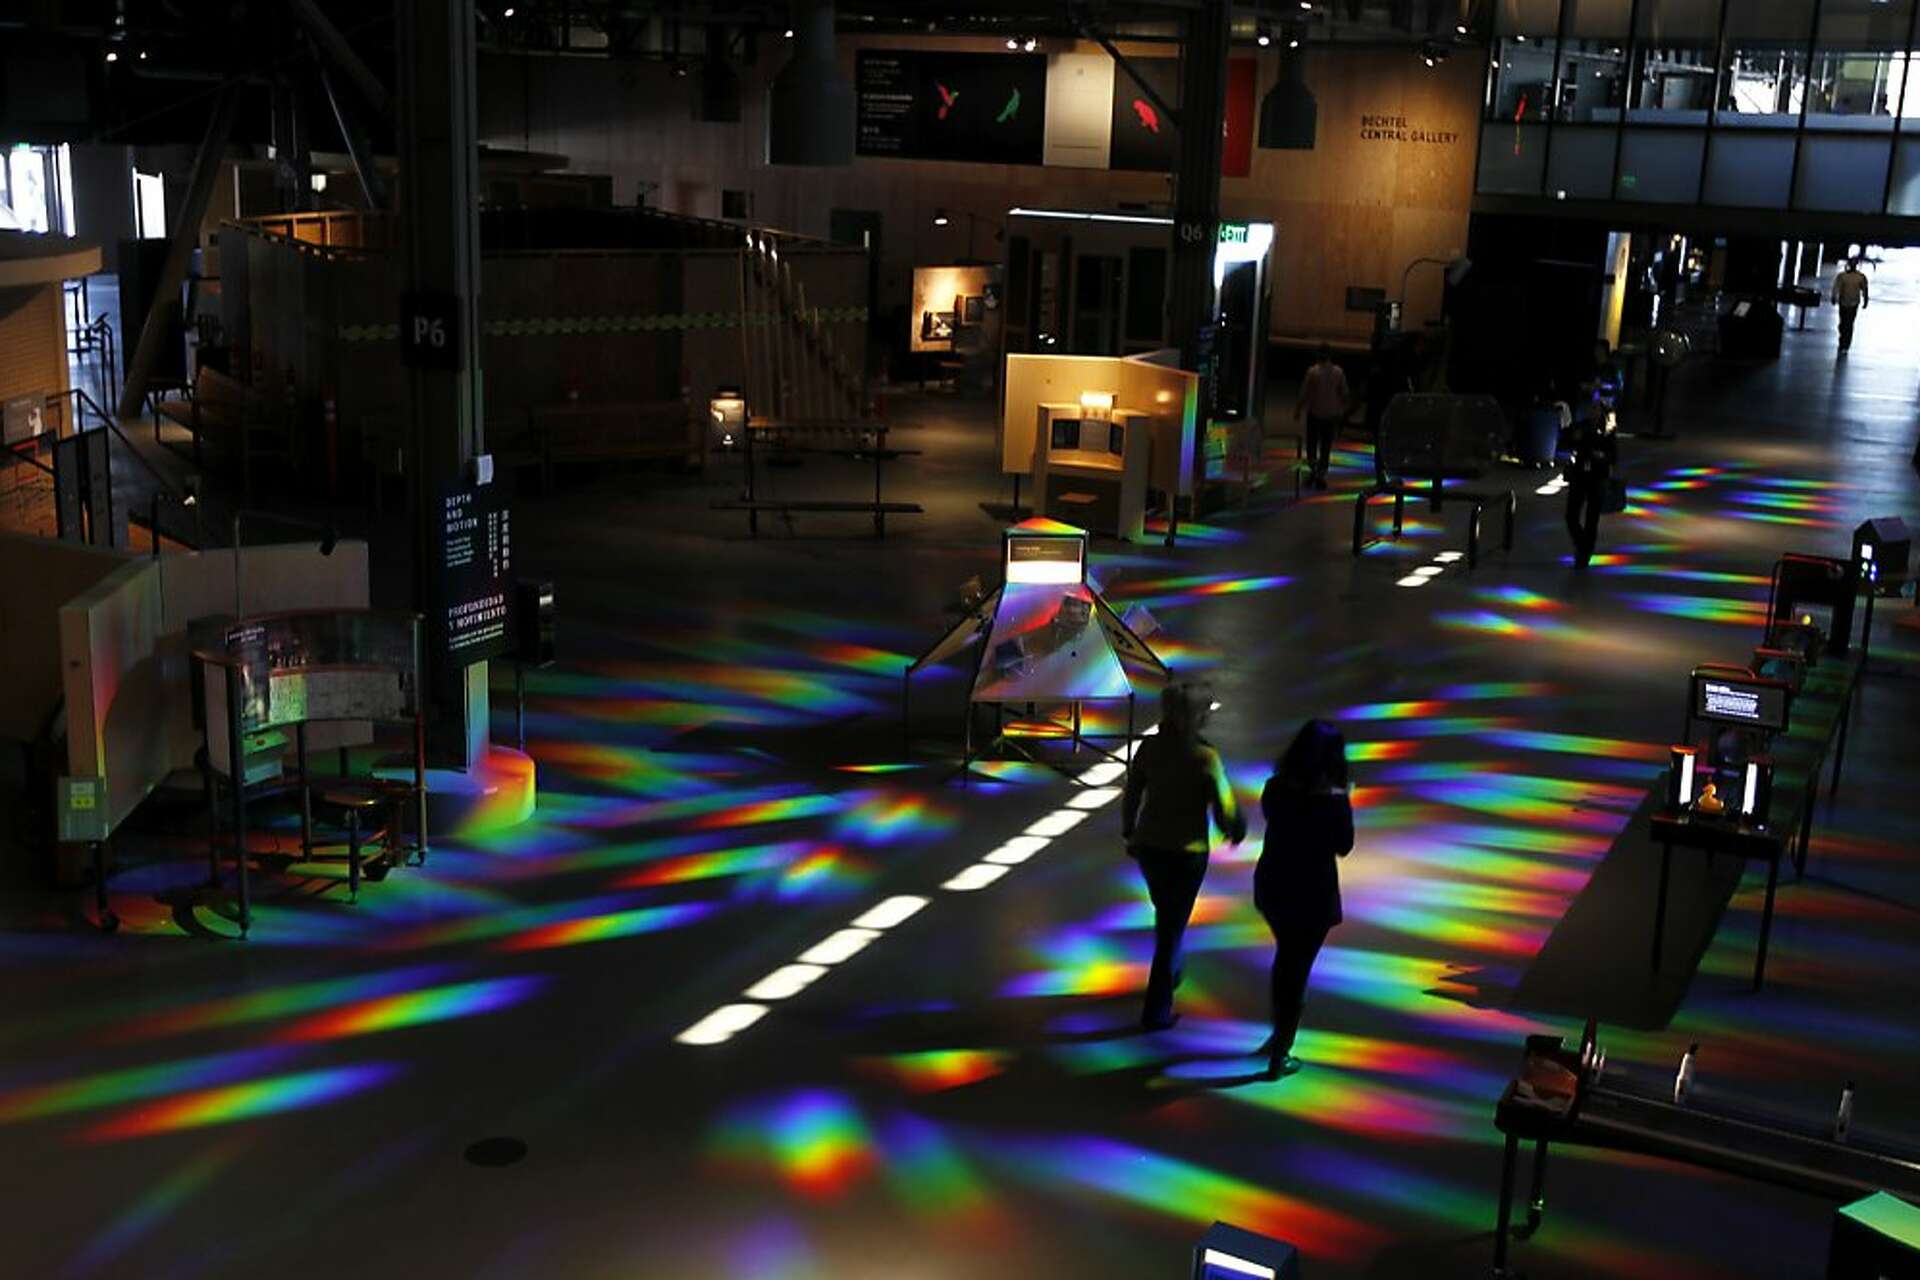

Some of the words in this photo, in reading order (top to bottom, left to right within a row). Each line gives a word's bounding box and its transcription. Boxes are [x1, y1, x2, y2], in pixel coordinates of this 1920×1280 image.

[1362, 114, 1407, 128] BECHTEL
[1361, 129, 1407, 142] CENTRAL
[1411, 130, 1458, 143] GALLERY
[1226, 224, 1247, 242] EXIT
[413, 314, 446, 349] P6
[445, 493, 472, 509] DEPTH
[446, 507, 463, 521] AND
[446, 517, 479, 534] MOTION
